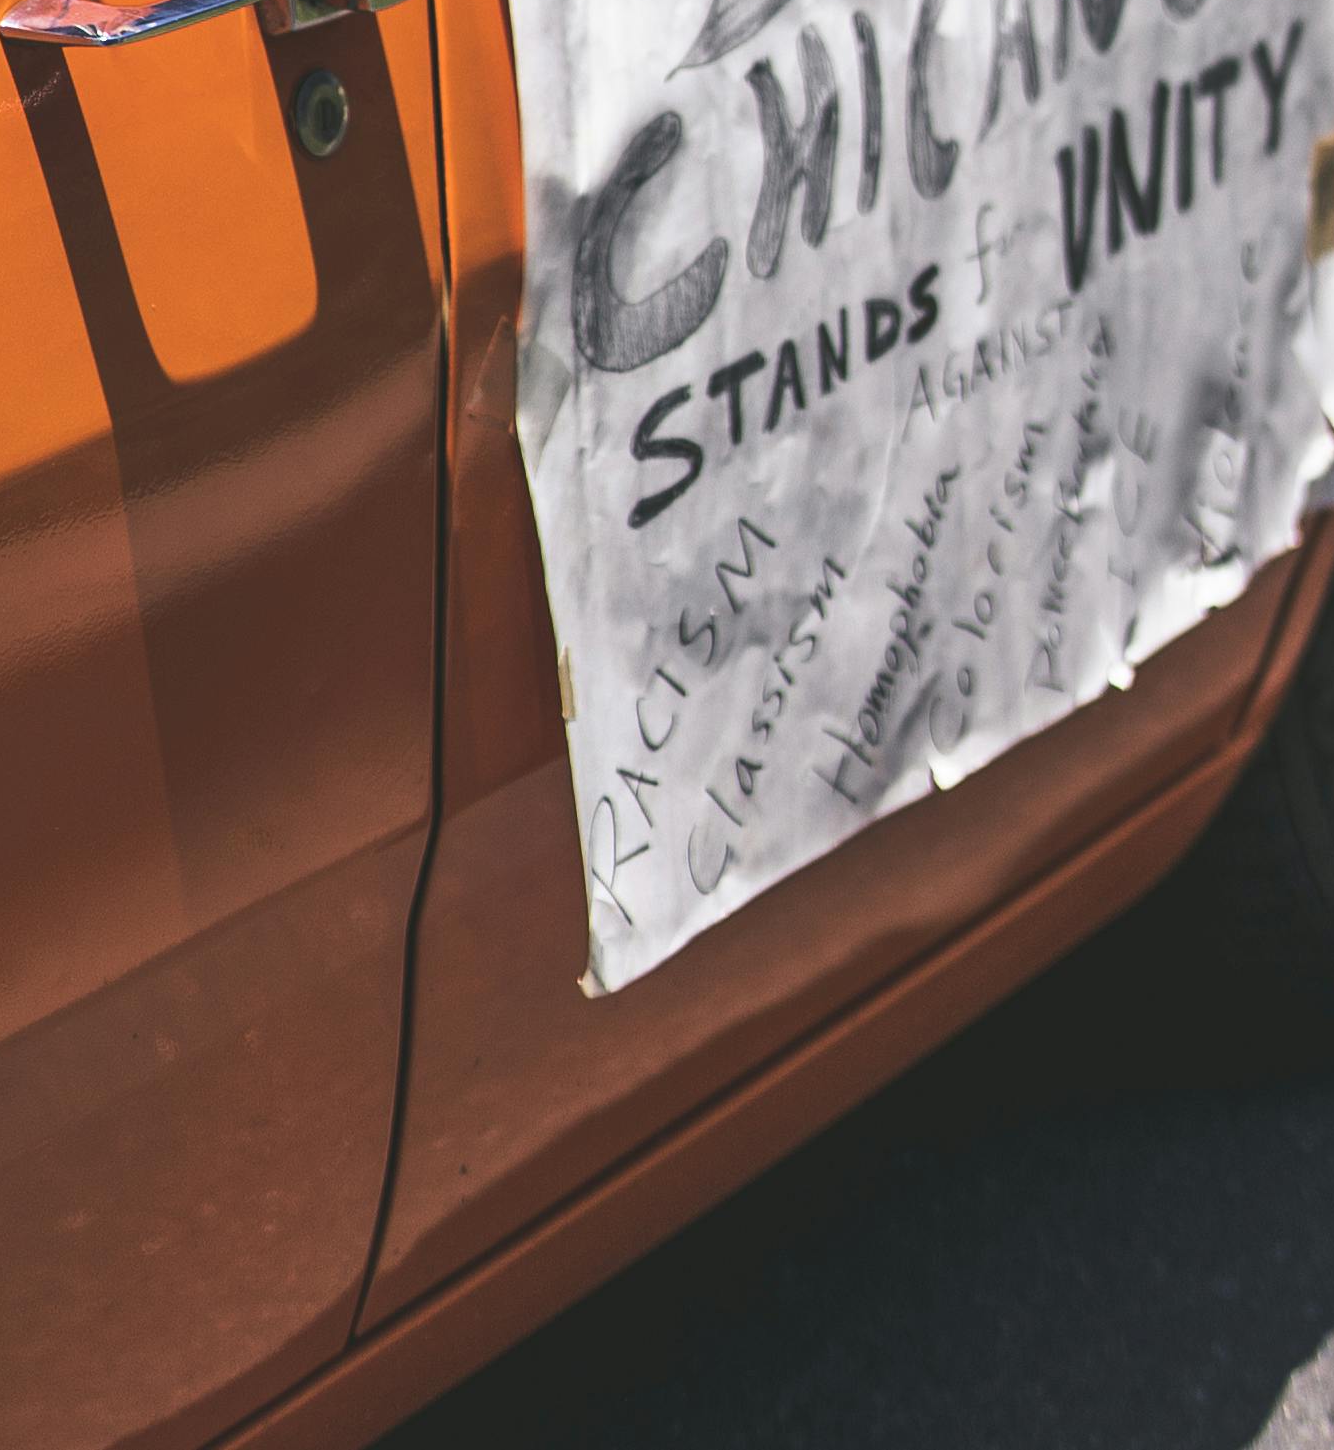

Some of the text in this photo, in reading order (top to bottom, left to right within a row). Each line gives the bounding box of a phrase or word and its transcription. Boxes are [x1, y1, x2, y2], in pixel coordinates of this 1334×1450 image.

[627, 262, 940, 529] STANDS
[1055, 17, 1305, 294] UNITY
[900, 298, 1074, 445] AGAINST
[588, 517, 777, 927] RACISM
